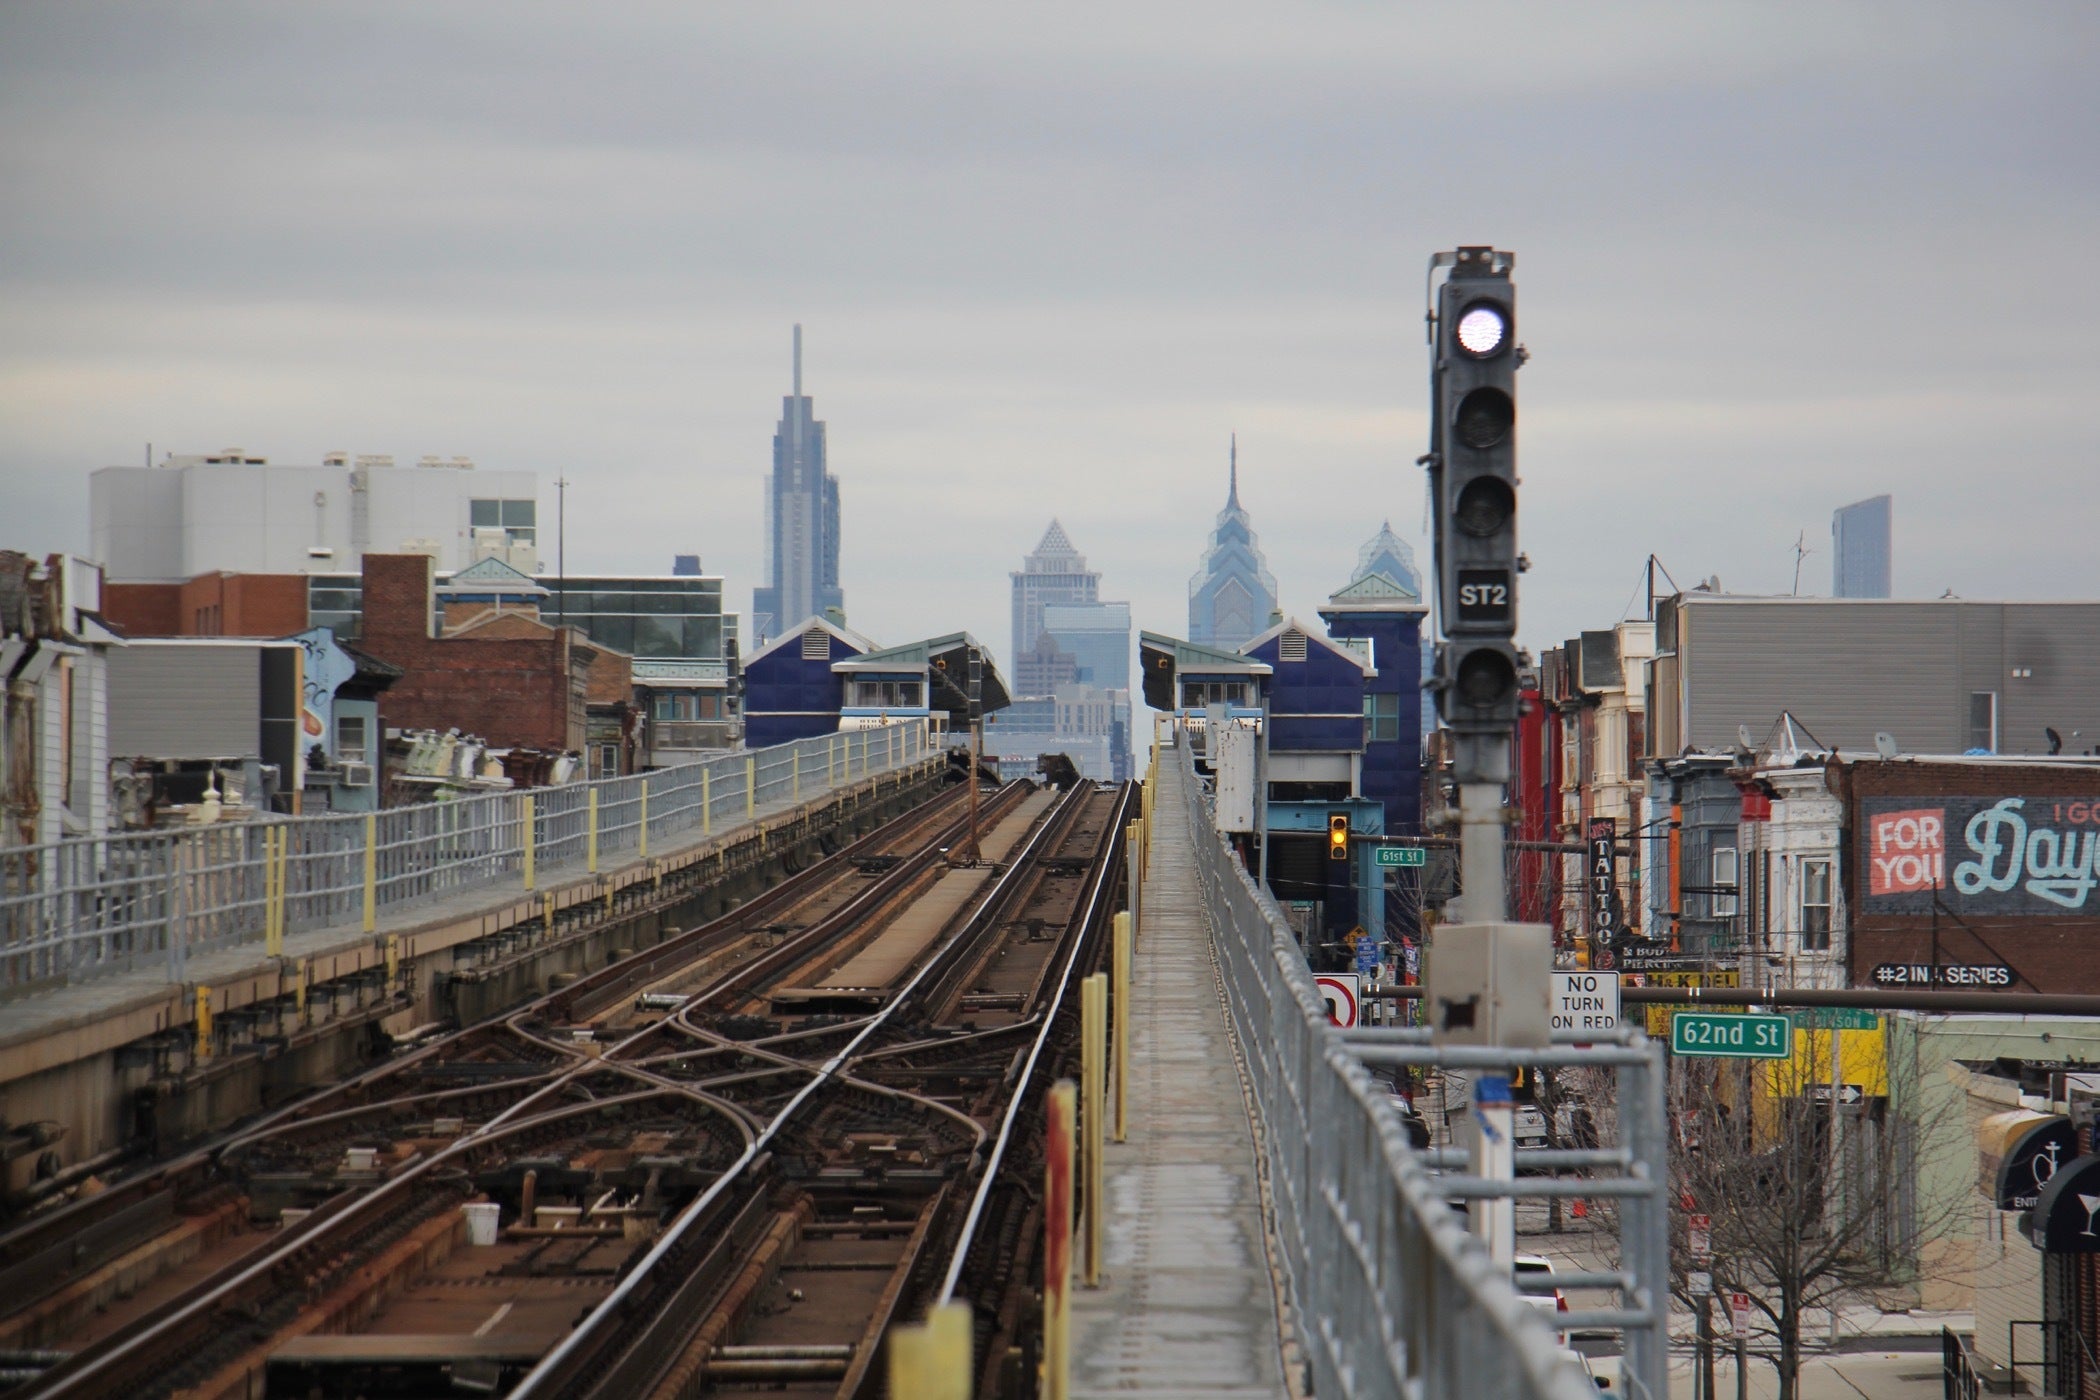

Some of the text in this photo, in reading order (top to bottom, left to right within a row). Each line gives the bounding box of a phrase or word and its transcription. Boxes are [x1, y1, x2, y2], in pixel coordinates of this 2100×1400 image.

[1460, 584, 1507, 606] ST2
[1877, 815, 1941, 854] FOR
[1383, 851, 1418, 862] 61st St
[1953, 797, 2100, 909] Day
[1873, 853, 1943, 889] YOU
[1595, 840, 1612, 945] TATTOO
[1567, 976, 1597, 992] NO
[1877, 966, 1907, 982] #2
[1910, 966, 1929, 983] IN
[1946, 966, 2010, 985] SERIES
[1562, 997, 1604, 1011] TURN
[1551, 1015, 1614, 1029] ON RED
[1684, 1021, 1744, 1045] 62nd
[1755, 1023, 1778, 1046] St
